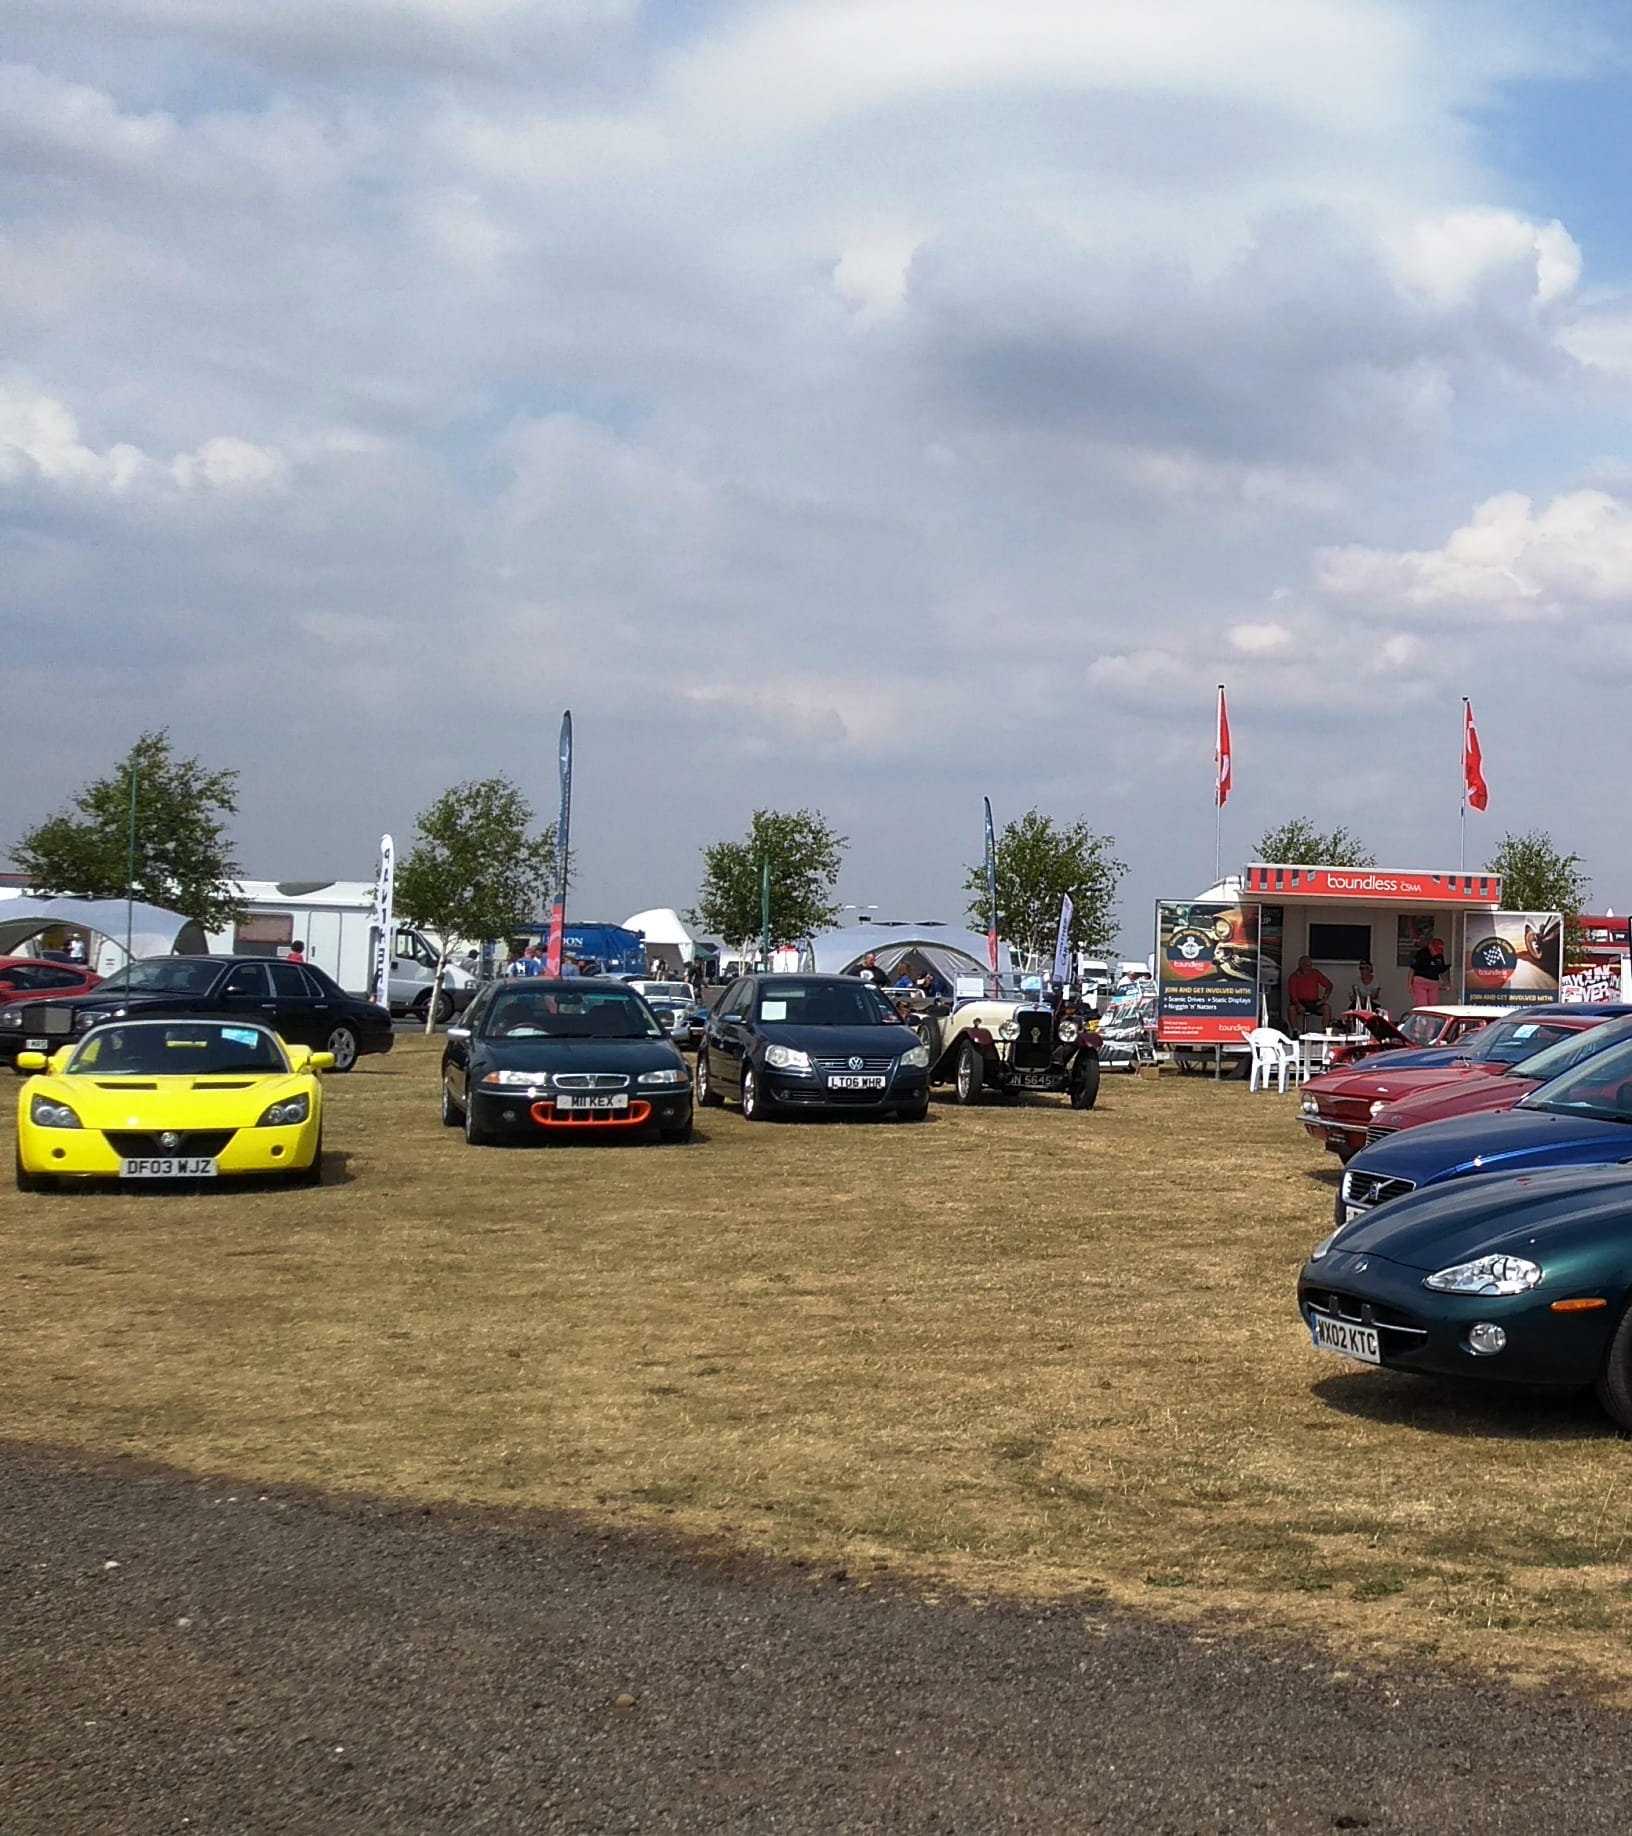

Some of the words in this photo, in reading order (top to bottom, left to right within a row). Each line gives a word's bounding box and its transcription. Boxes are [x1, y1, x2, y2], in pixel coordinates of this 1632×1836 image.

[1327, 873, 1398, 891] boundless
[831, 1077, 860, 1088] LT06
[862, 1077, 883, 1088] WHR
[590, 1095, 614, 1107] KEX
[127, 1160, 173, 1174] DF03
[178, 1160, 211, 1174] WJZ
[1317, 1319, 1347, 1350] WX02
[1349, 1328, 1377, 1355] KTC
